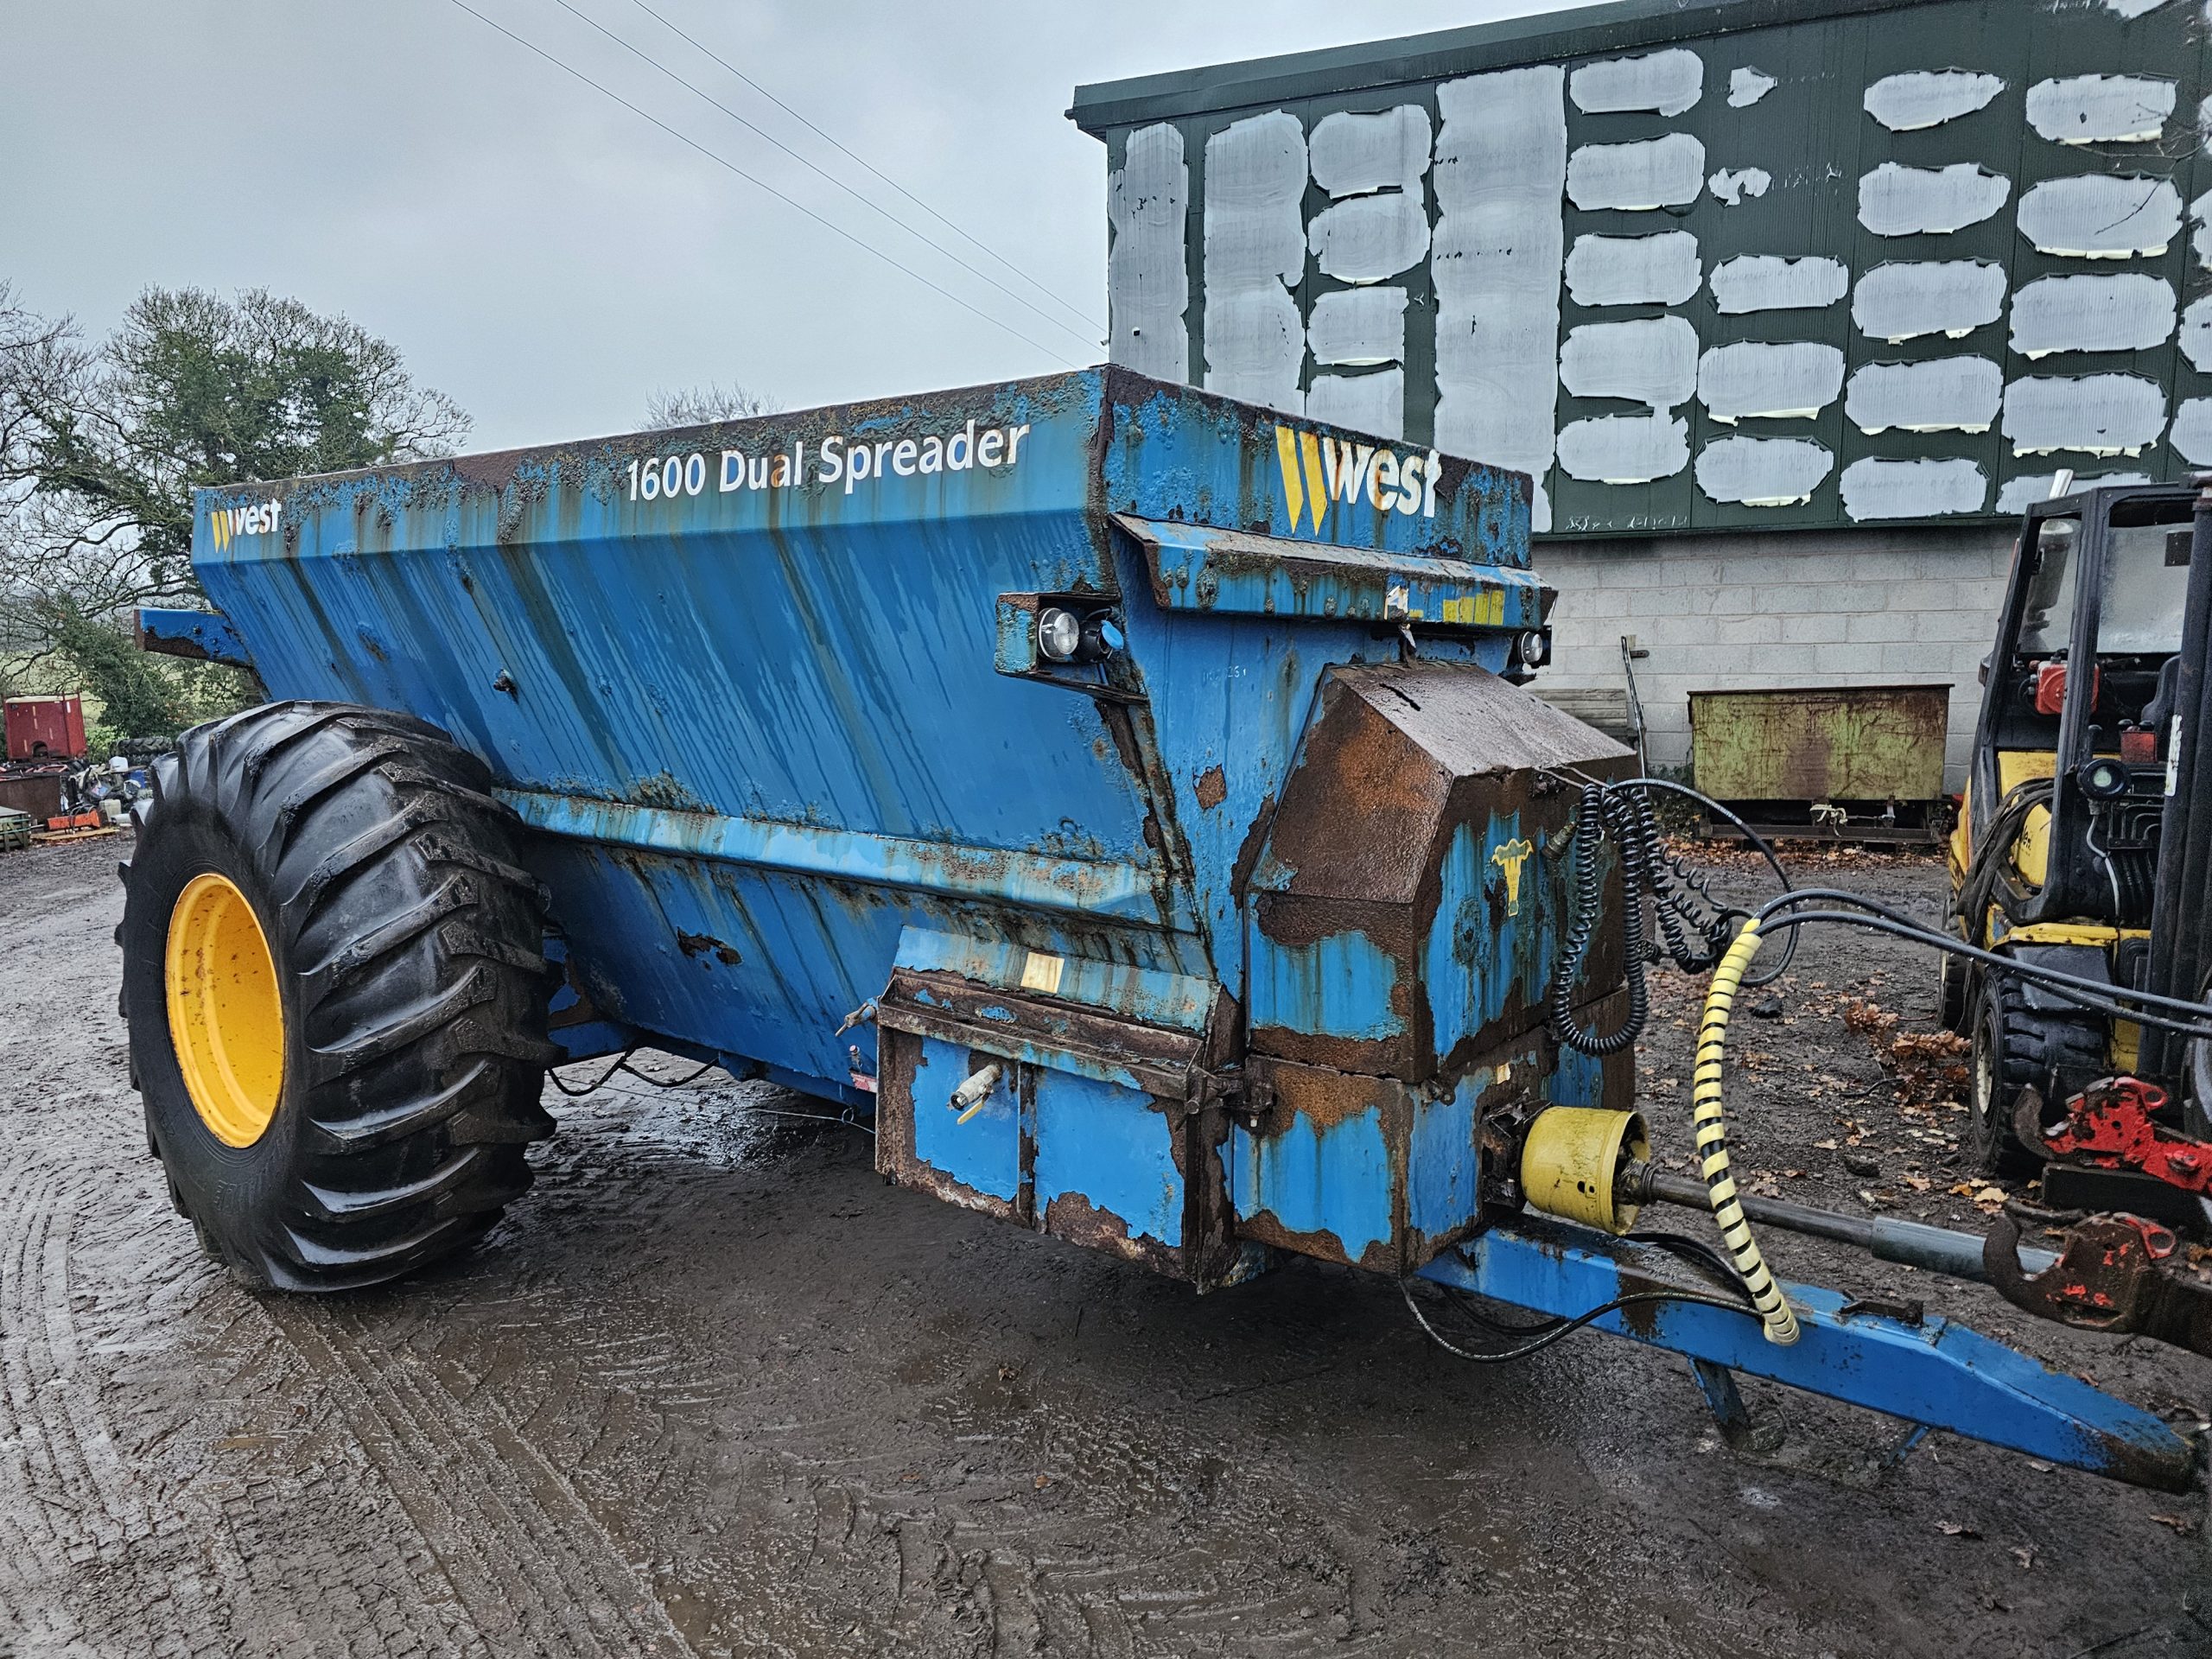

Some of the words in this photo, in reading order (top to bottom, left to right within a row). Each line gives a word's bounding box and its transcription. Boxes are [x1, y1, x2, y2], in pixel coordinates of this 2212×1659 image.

[626, 452, 707, 502] 1600
[719, 441, 804, 493] Dual
[817, 418, 1031, 495] Spreader
